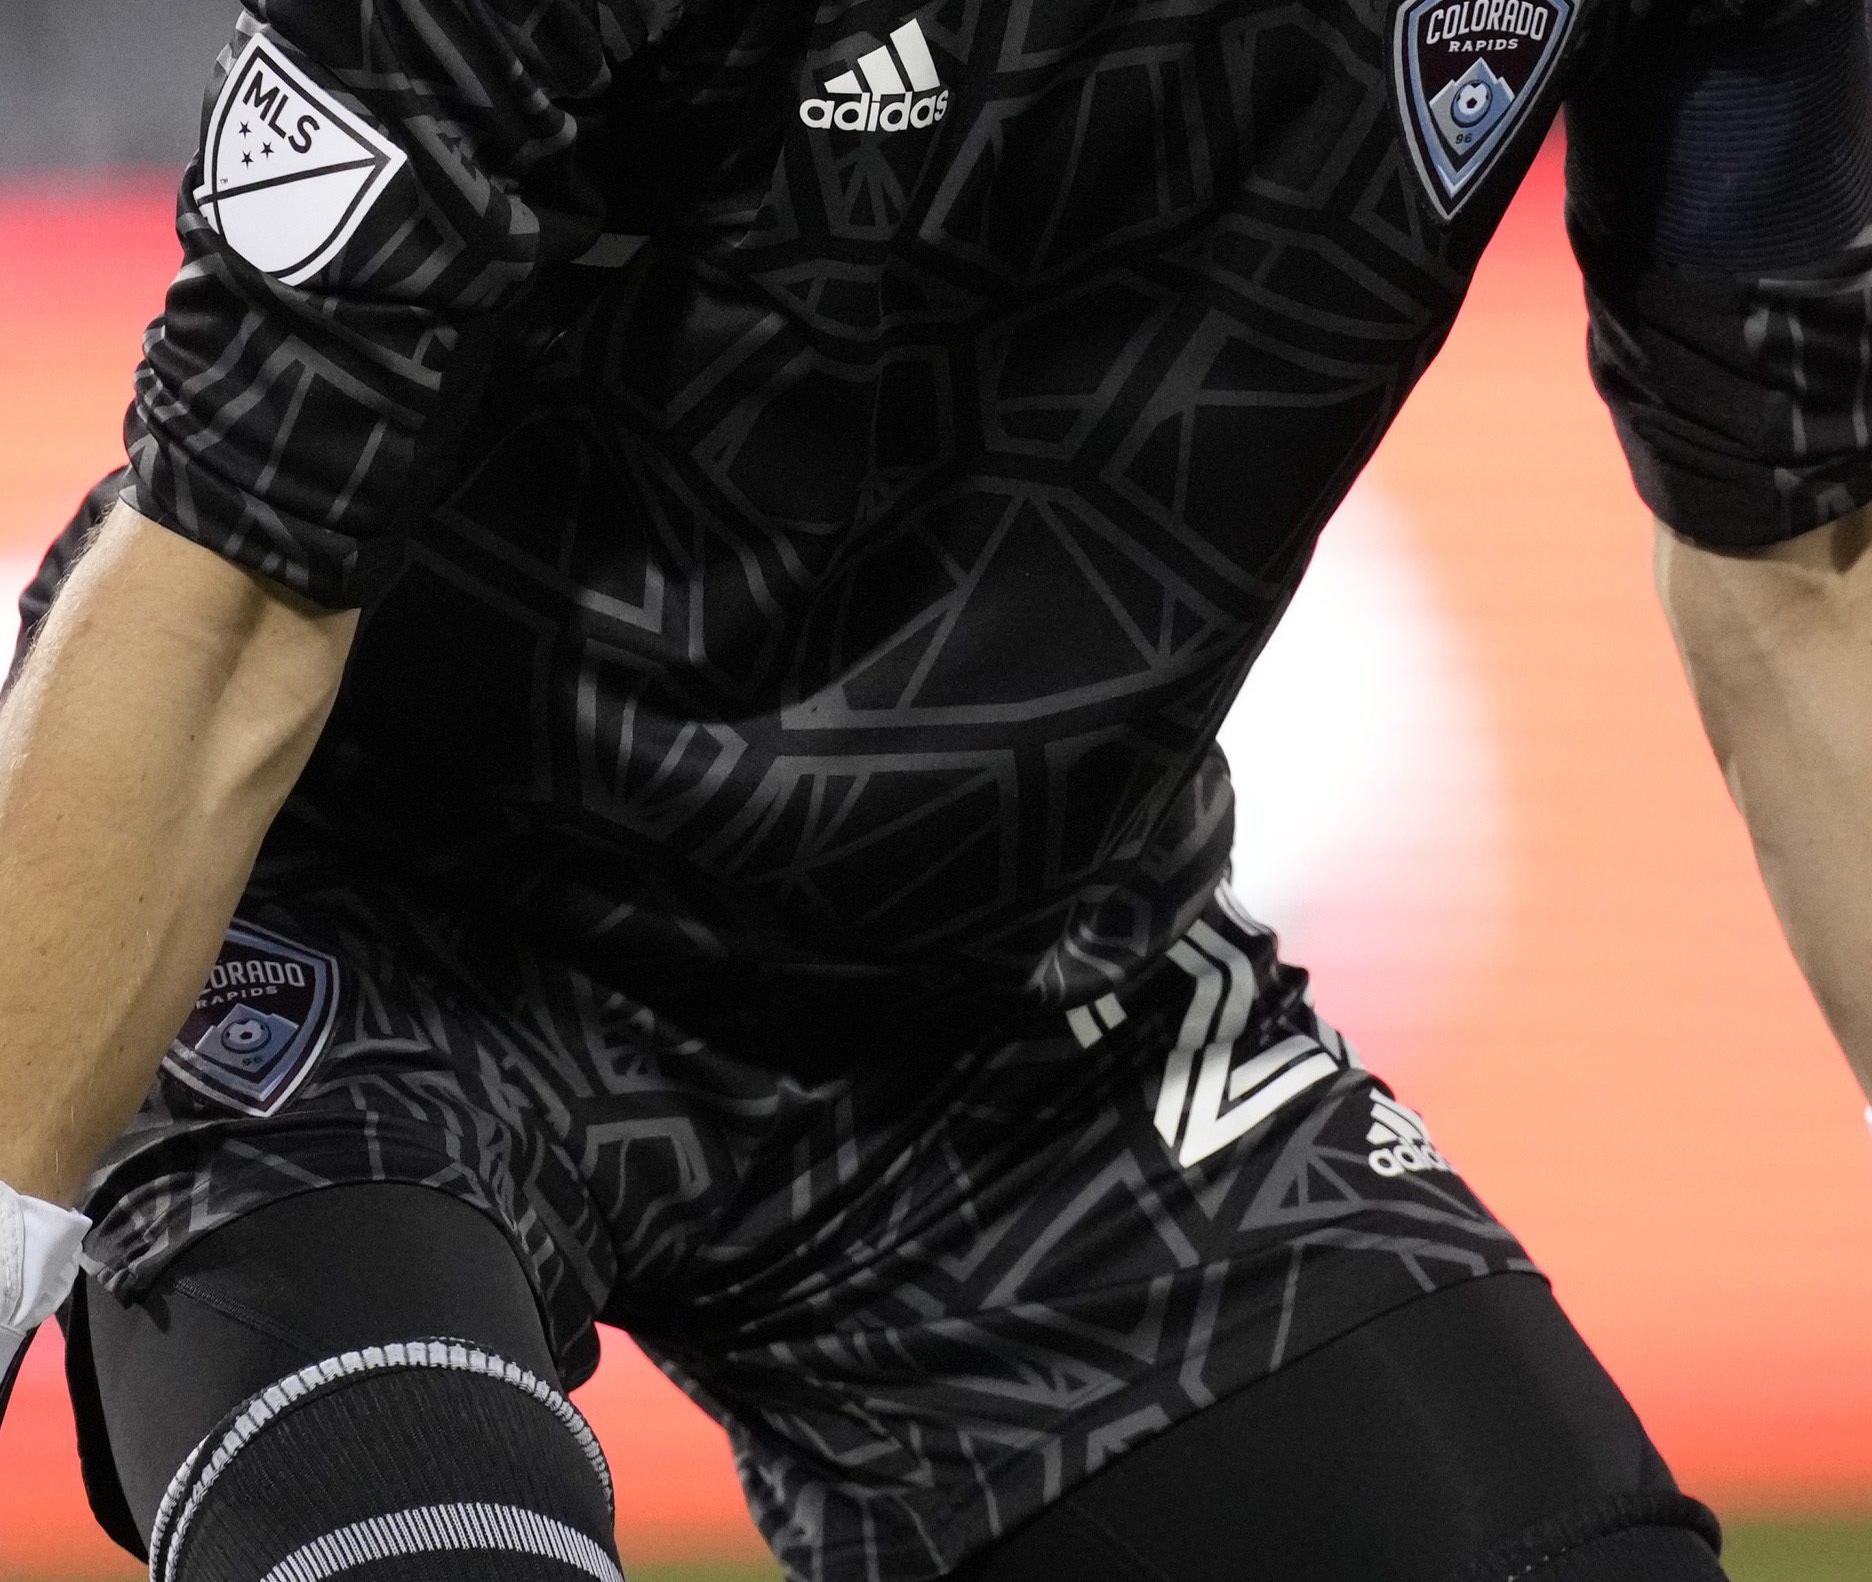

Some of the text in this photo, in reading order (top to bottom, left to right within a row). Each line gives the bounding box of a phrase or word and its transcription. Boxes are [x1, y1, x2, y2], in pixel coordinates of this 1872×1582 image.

[1448, 38, 1519, 52] RAPIDS
[242, 70, 320, 154] MLS
[799, 89, 949, 132] adidas
[200, 960, 305, 995] ORADO
